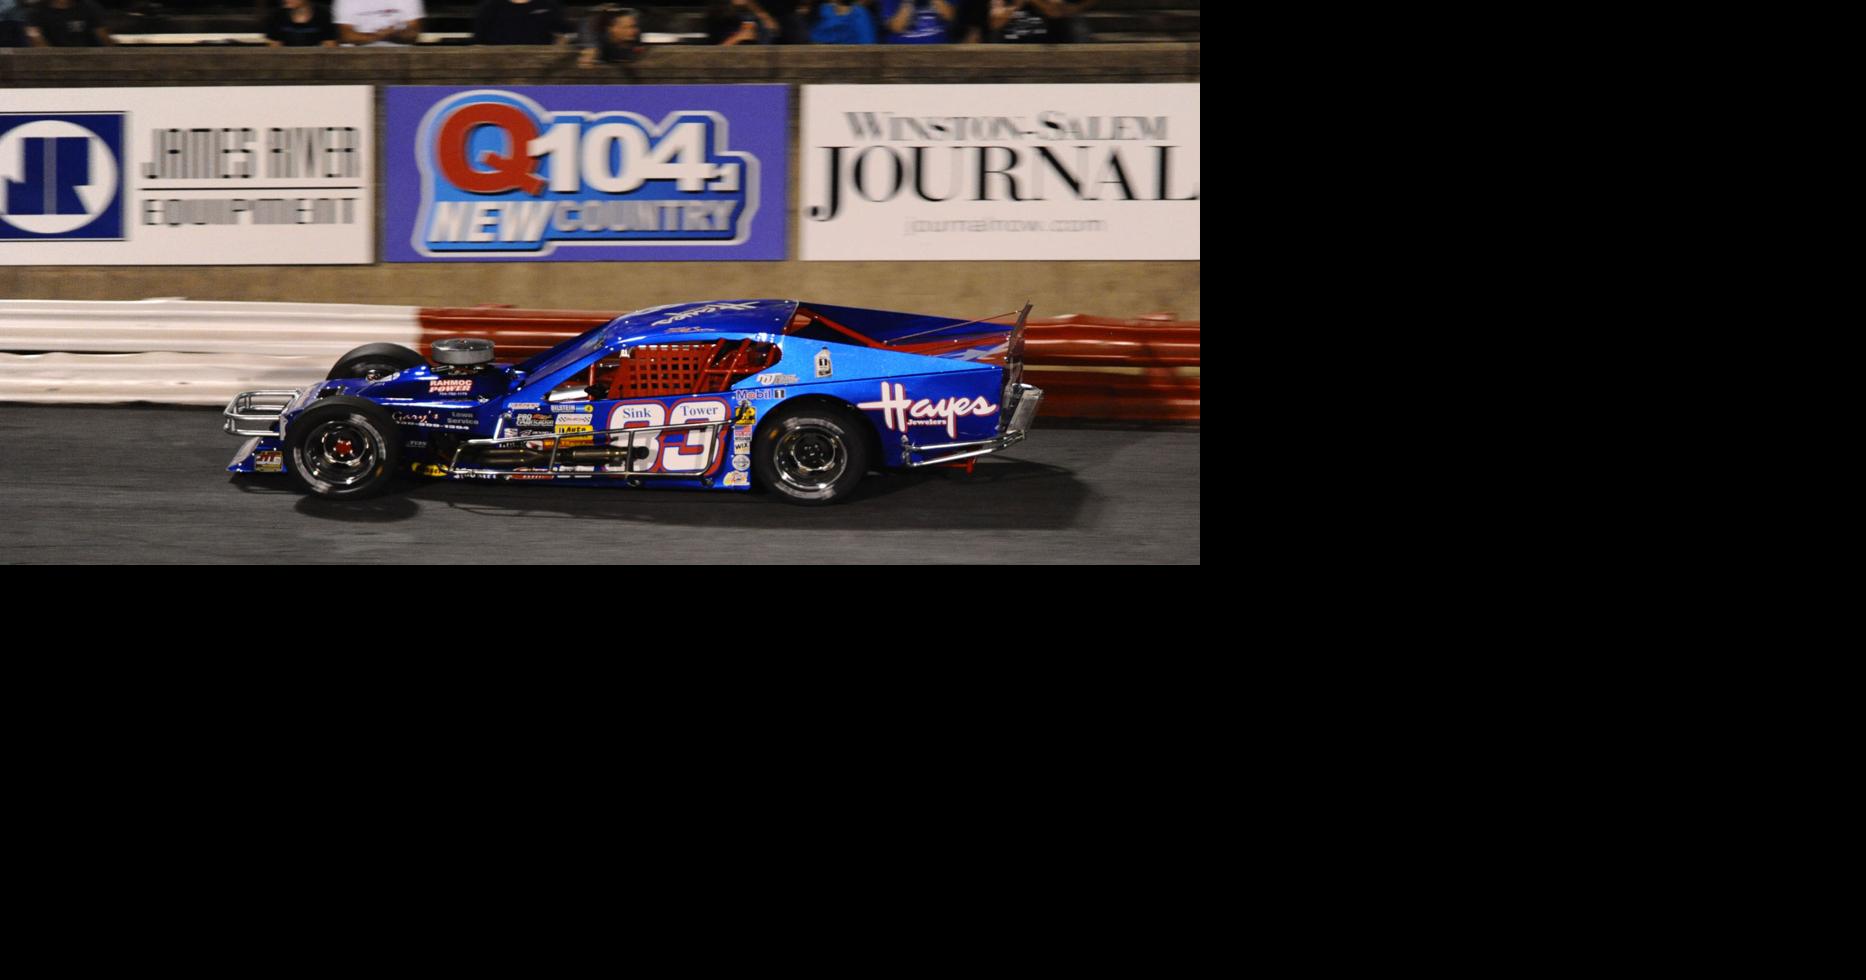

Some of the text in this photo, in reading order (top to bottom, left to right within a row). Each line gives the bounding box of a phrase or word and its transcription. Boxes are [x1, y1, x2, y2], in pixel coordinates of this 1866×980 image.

[806, 145, 1199, 222] JOURNAL
[427, 200, 740, 243] NEW COUNTRY
[428, 385, 472, 393] POWER
[735, 389, 785, 401] Mobil 1
[622, 405, 719, 419] Sink Tower
[856, 380, 999, 439] Hayes
[907, 418, 947, 426] Jewelers
[735, 441, 748, 450] WIX
